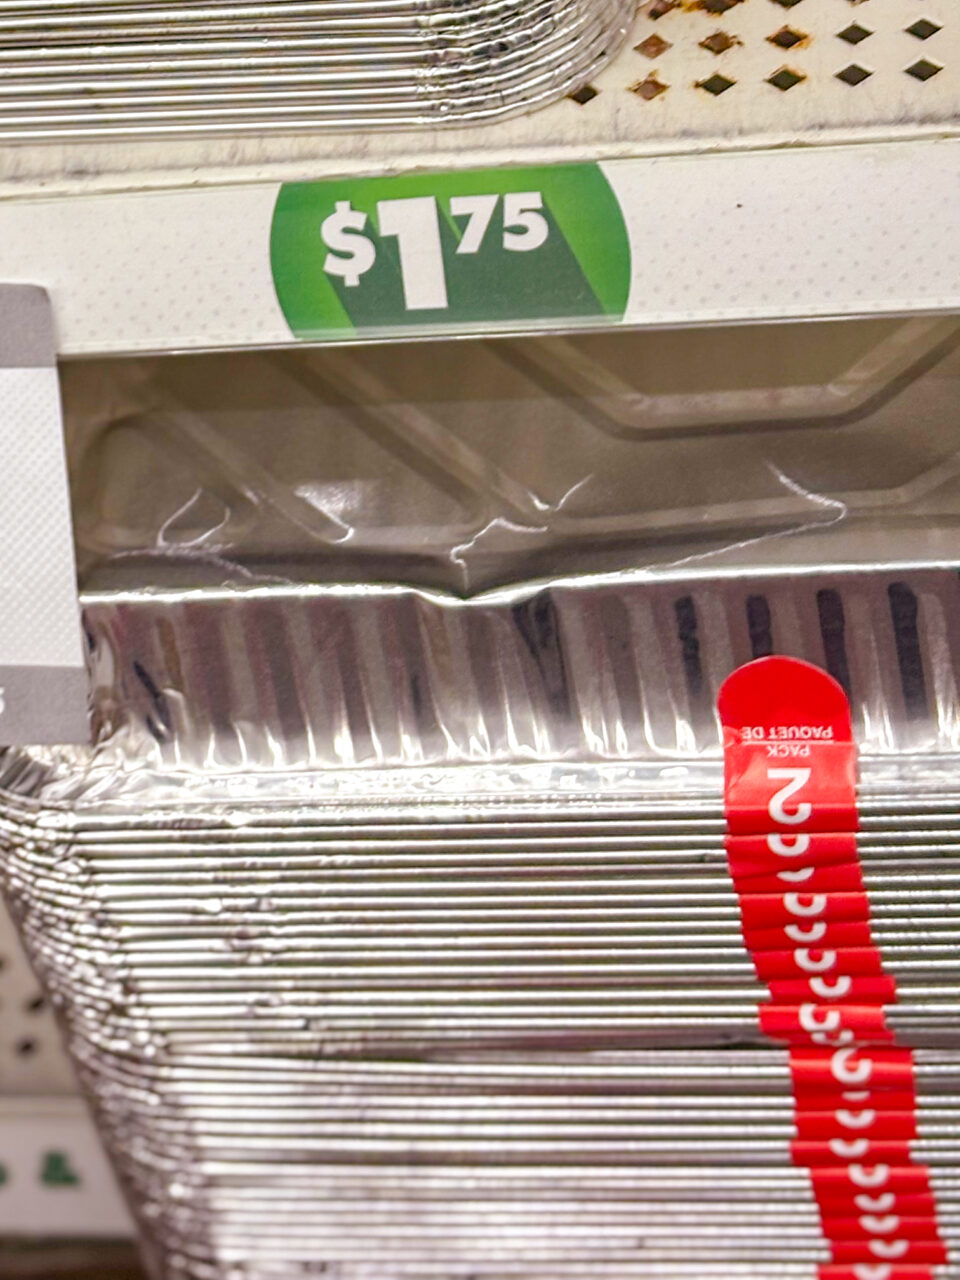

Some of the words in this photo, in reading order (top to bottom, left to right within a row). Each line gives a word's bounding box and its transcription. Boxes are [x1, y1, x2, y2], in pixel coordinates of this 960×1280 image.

[741, 726, 764, 740] DE
[769, 725, 834, 740] PAQUET
[766, 744, 811, 758] PACK
